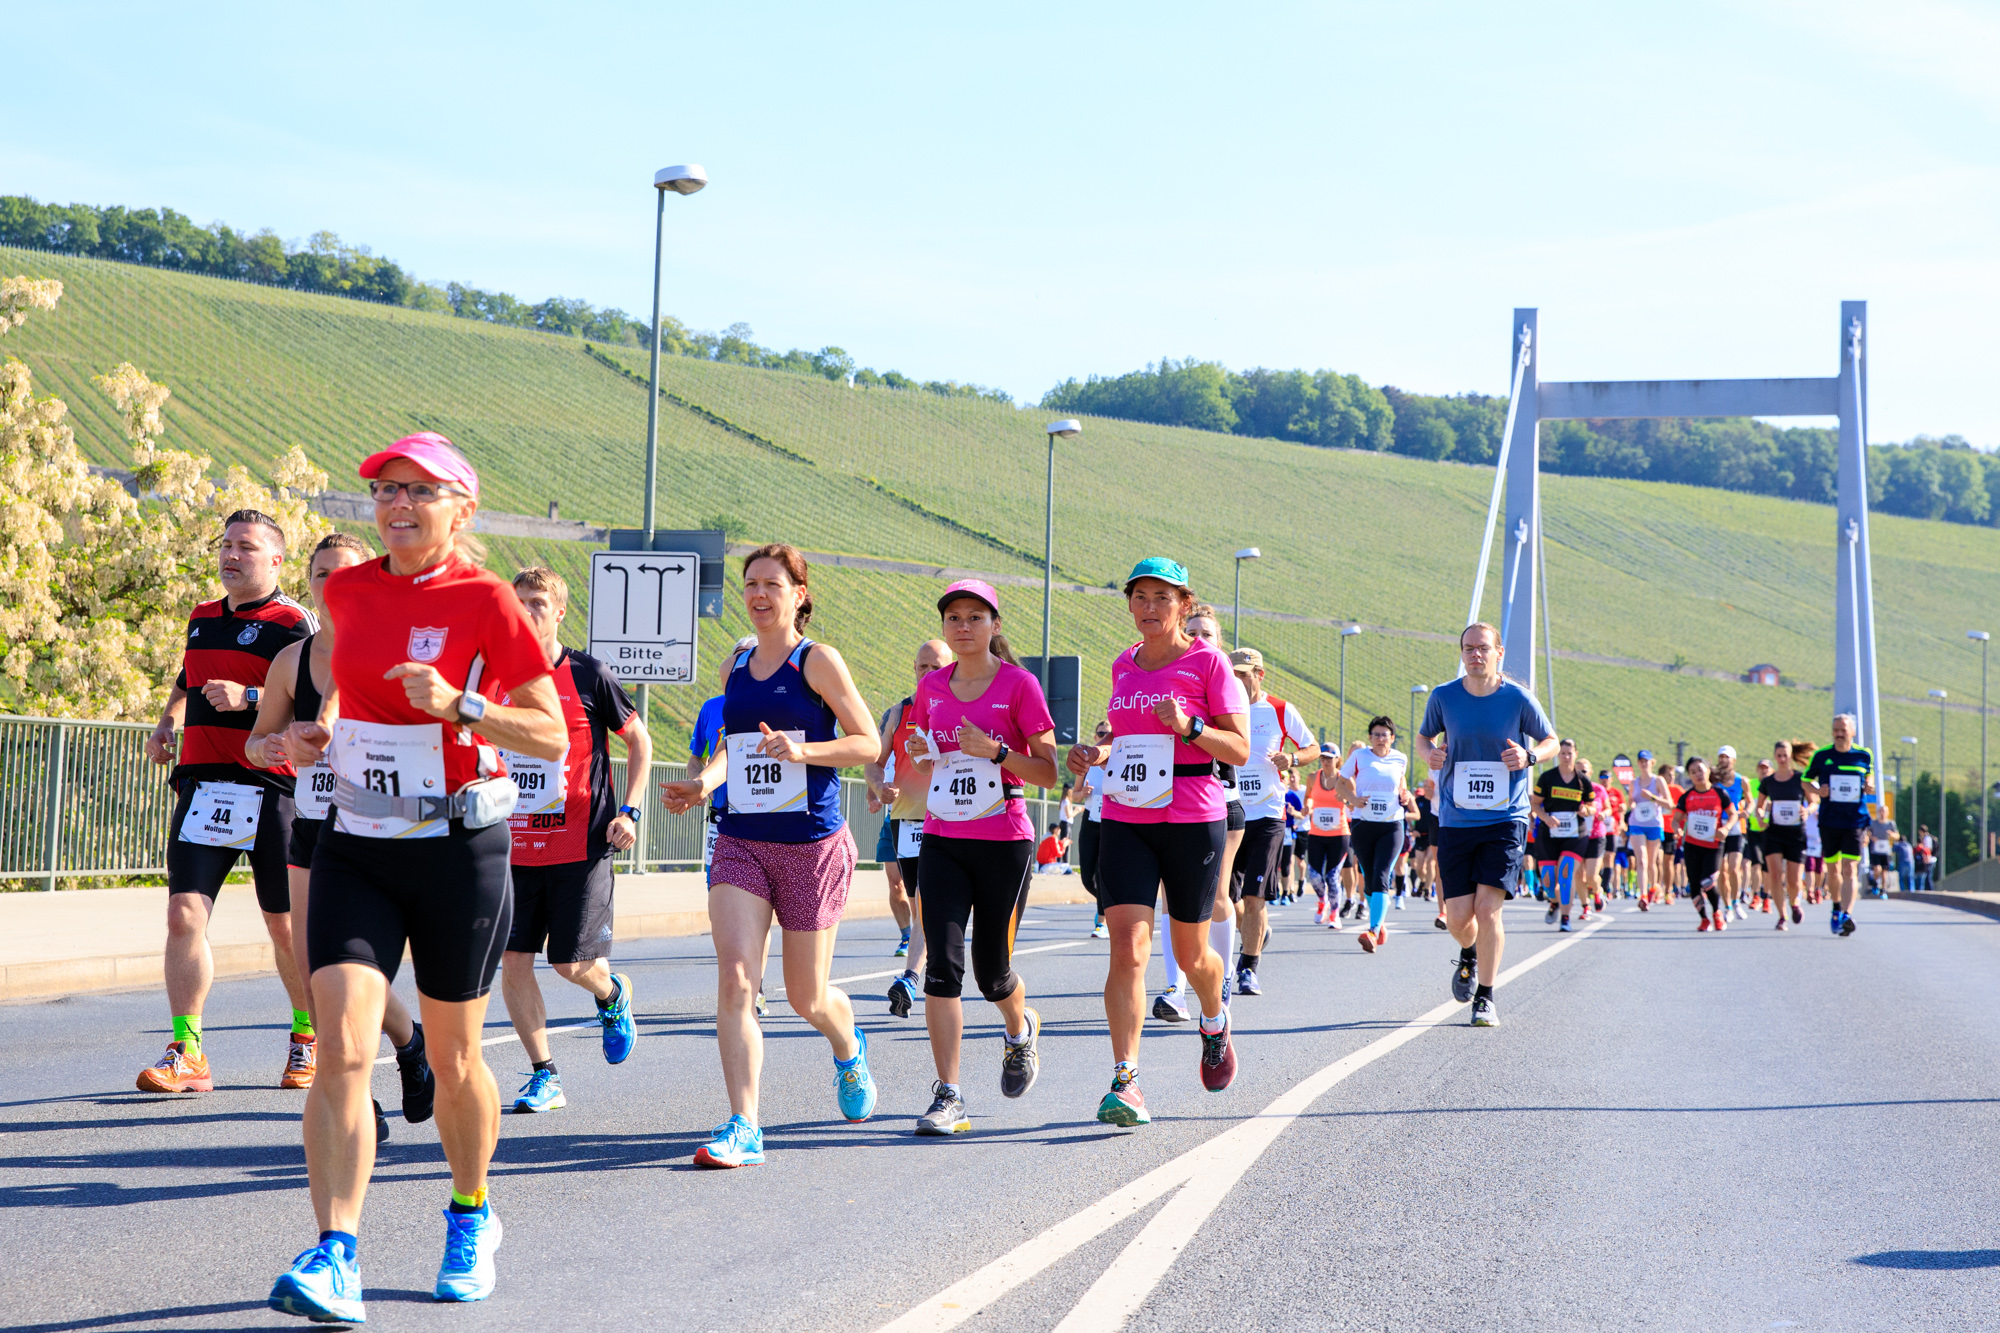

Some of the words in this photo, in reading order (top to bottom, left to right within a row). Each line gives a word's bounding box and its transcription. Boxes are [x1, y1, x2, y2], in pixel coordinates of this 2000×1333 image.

[619, 647, 663, 660] Bitte
[366, 752, 396, 762] Marathon
[744, 763, 782, 784] 1218
[1120, 763, 1147, 782] 419
[311, 772, 337, 793] 138
[363, 768, 401, 797] 131
[511, 772, 546, 790] 2091
[949, 776, 977, 795] 418
[1239, 779, 1261, 791] 1815
[1467, 780, 1494, 793] 1479
[751, 787, 775, 796] Carolin
[1125, 784, 1139, 792] Gabi
[214, 798, 235, 806] Marathon
[954, 798, 973, 806] Maria
[1370, 802, 1387, 811] 1816
[211, 808, 231, 825] 44
[204, 824, 234, 836] Wolfgang
